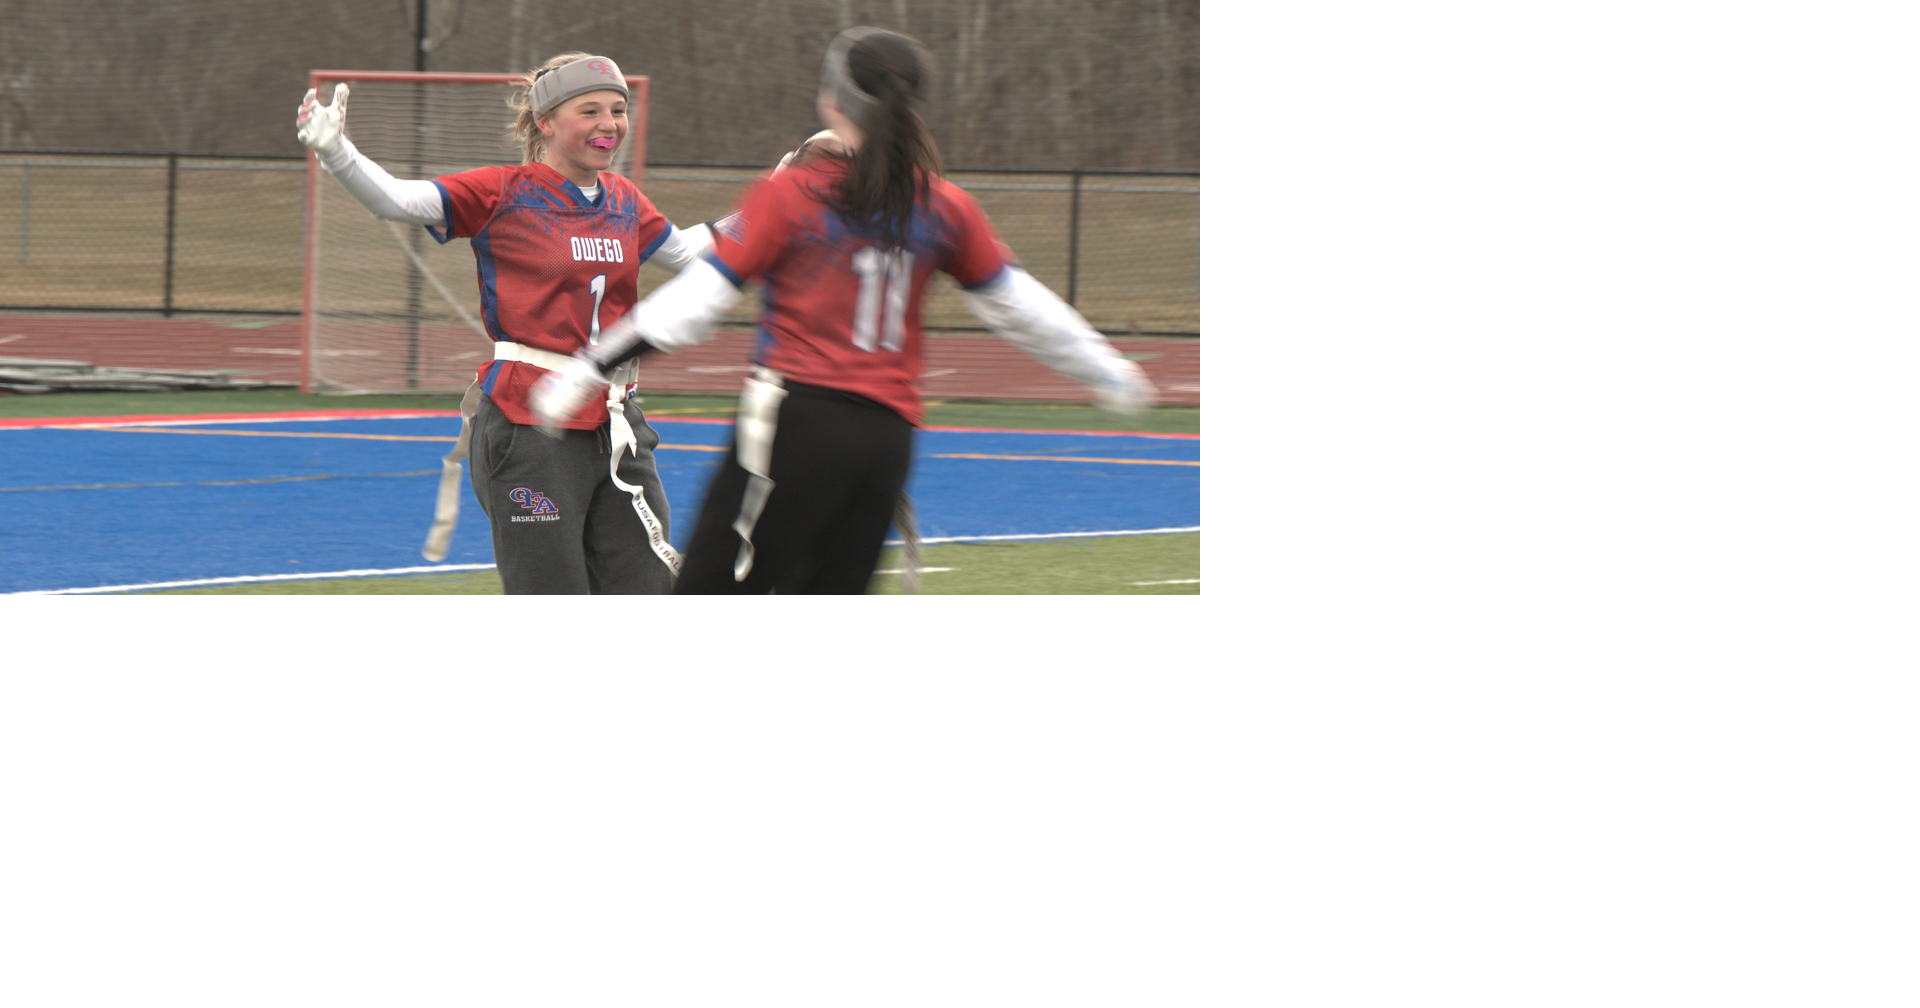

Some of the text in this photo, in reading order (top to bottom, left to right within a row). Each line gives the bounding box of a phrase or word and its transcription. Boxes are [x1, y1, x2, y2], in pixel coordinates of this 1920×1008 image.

[570, 236, 624, 263] OWEGO
[588, 273, 607, 346] 1
[852, 246, 915, 353] 11
[511, 514, 560, 522] BASKETBALL
